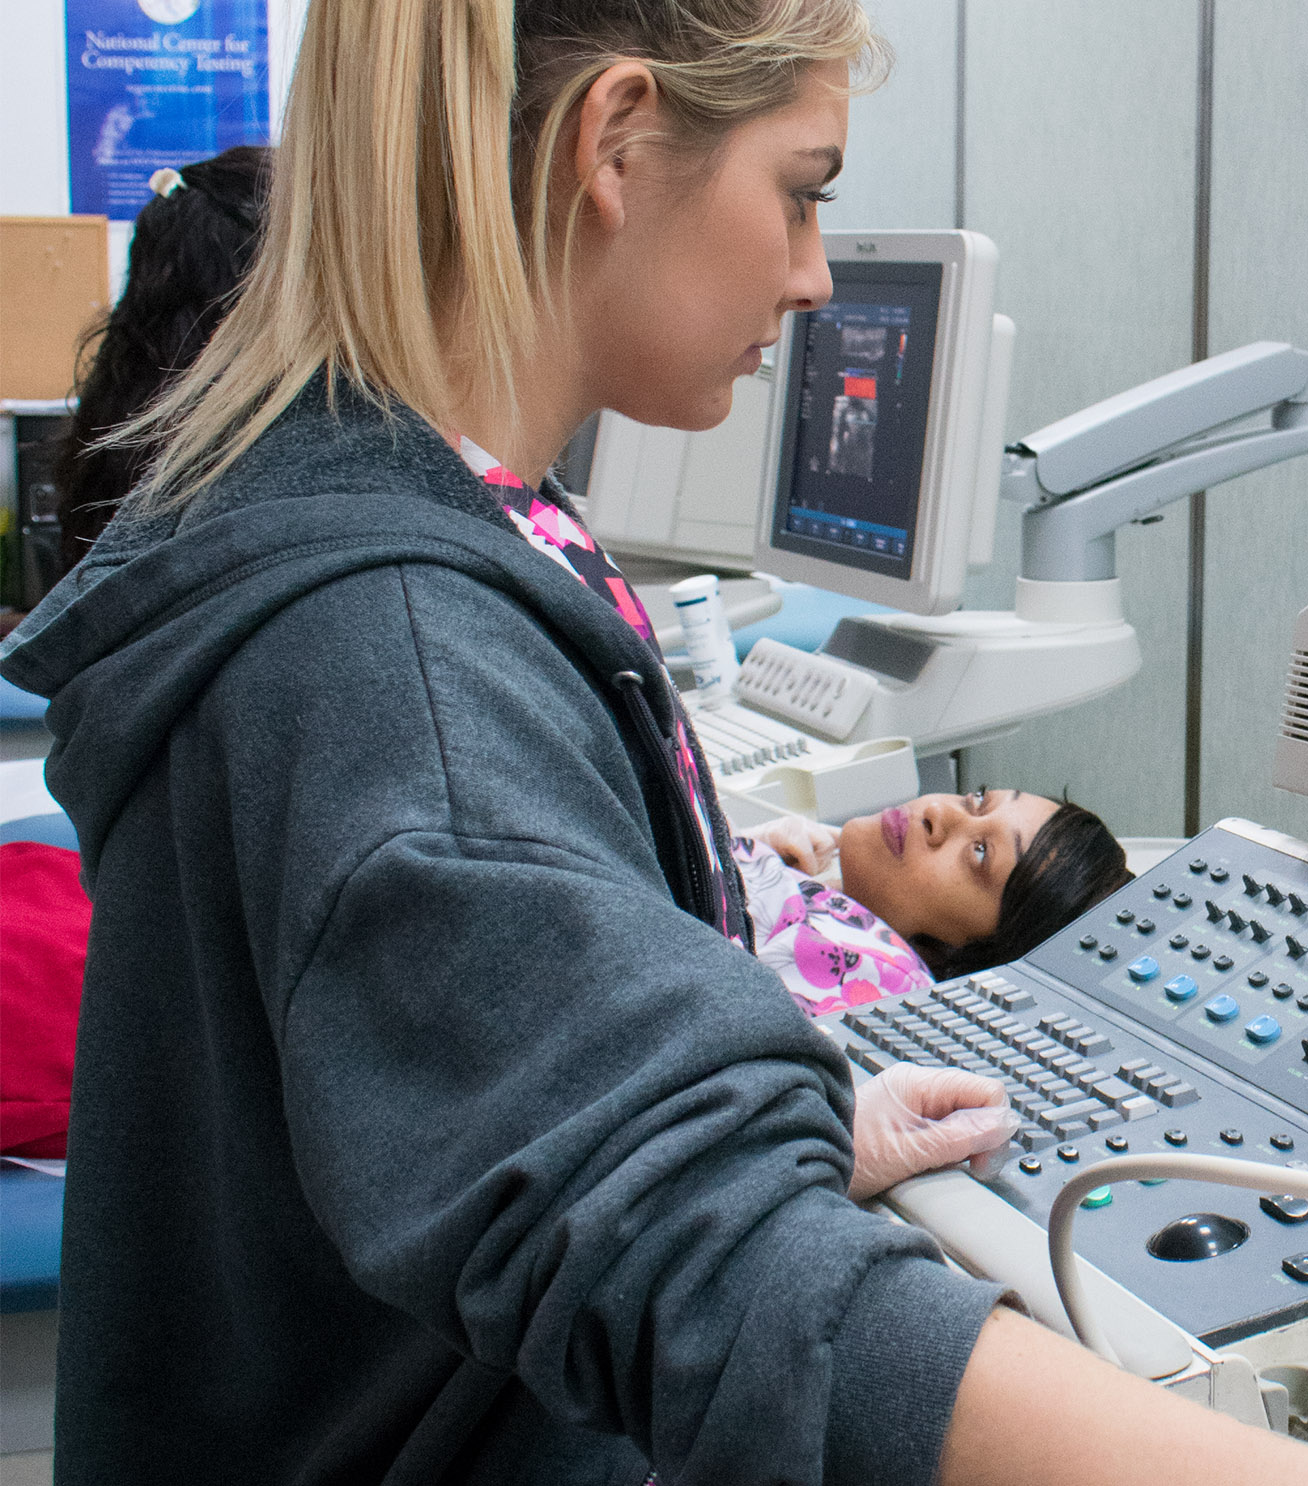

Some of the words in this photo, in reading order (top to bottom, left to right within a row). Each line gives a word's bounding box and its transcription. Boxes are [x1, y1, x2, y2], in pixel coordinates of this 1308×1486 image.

[85, 30, 161, 51] National
[162, 32, 221, 53] Center
[224, 33, 249, 52] for
[81, 50, 190, 77] Competency
[196, 52, 255, 79] Testing
